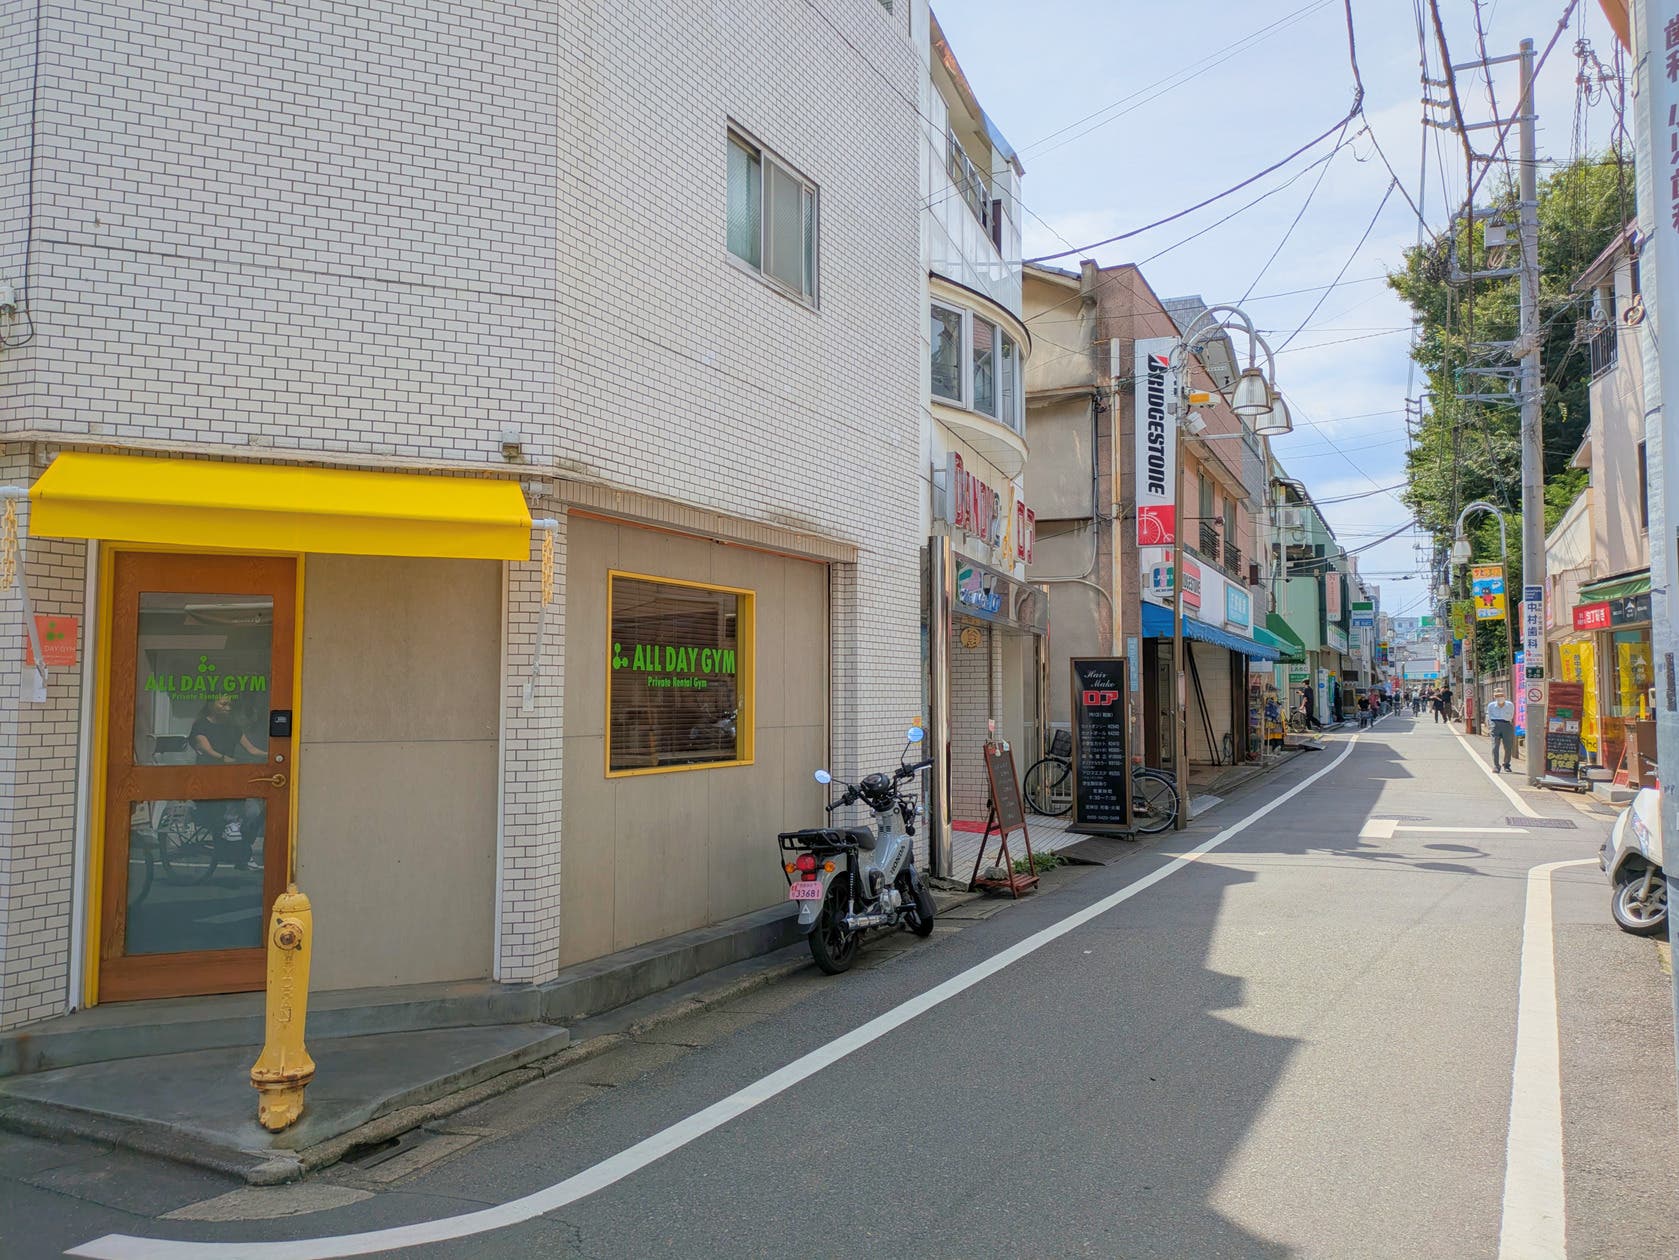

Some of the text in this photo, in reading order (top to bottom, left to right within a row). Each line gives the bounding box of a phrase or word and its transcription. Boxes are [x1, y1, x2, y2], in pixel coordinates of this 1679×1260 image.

[1148, 354, 1167, 495] BRIDGESTONE
[1527, 602, 1538, 649] 中村歯科
[632, 644, 736, 674] ALL DAY GYM
[145, 674, 267, 692] ALL DAY GYM
[647, 676, 707, 690] Private Rental Gym
[1084, 670, 1108, 679] Hair
[1091, 680, 1116, 688] Make
[172, 692, 198, 700] Private
[1083, 690, 1119, 706] ロア
[889, 845, 906, 875] HONDA
